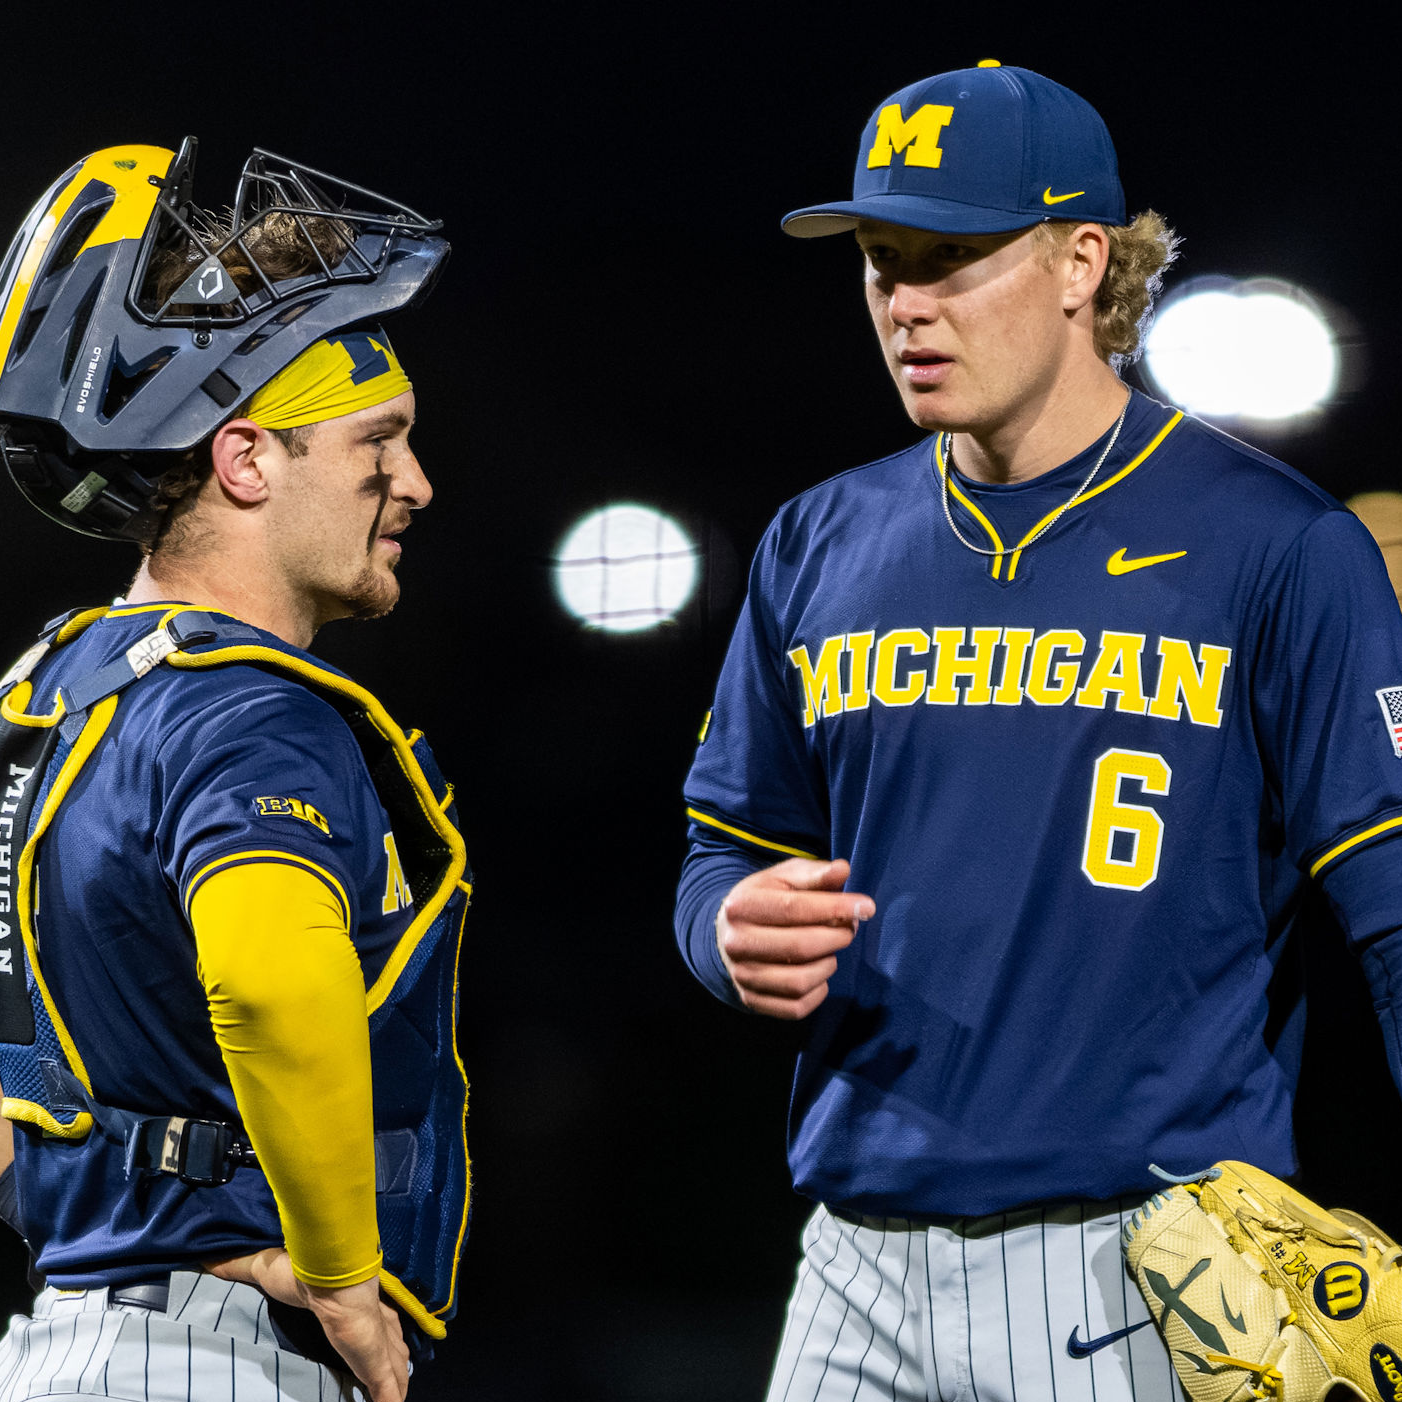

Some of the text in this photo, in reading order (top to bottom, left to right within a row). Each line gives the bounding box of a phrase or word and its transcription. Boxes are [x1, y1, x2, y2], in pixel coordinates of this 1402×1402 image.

[867, 103, 954, 169] M
[76, 346, 102, 413] EVOSHIELD
[787, 626, 1232, 729] MICHIGAN
[1081, 747, 1173, 892] 6
